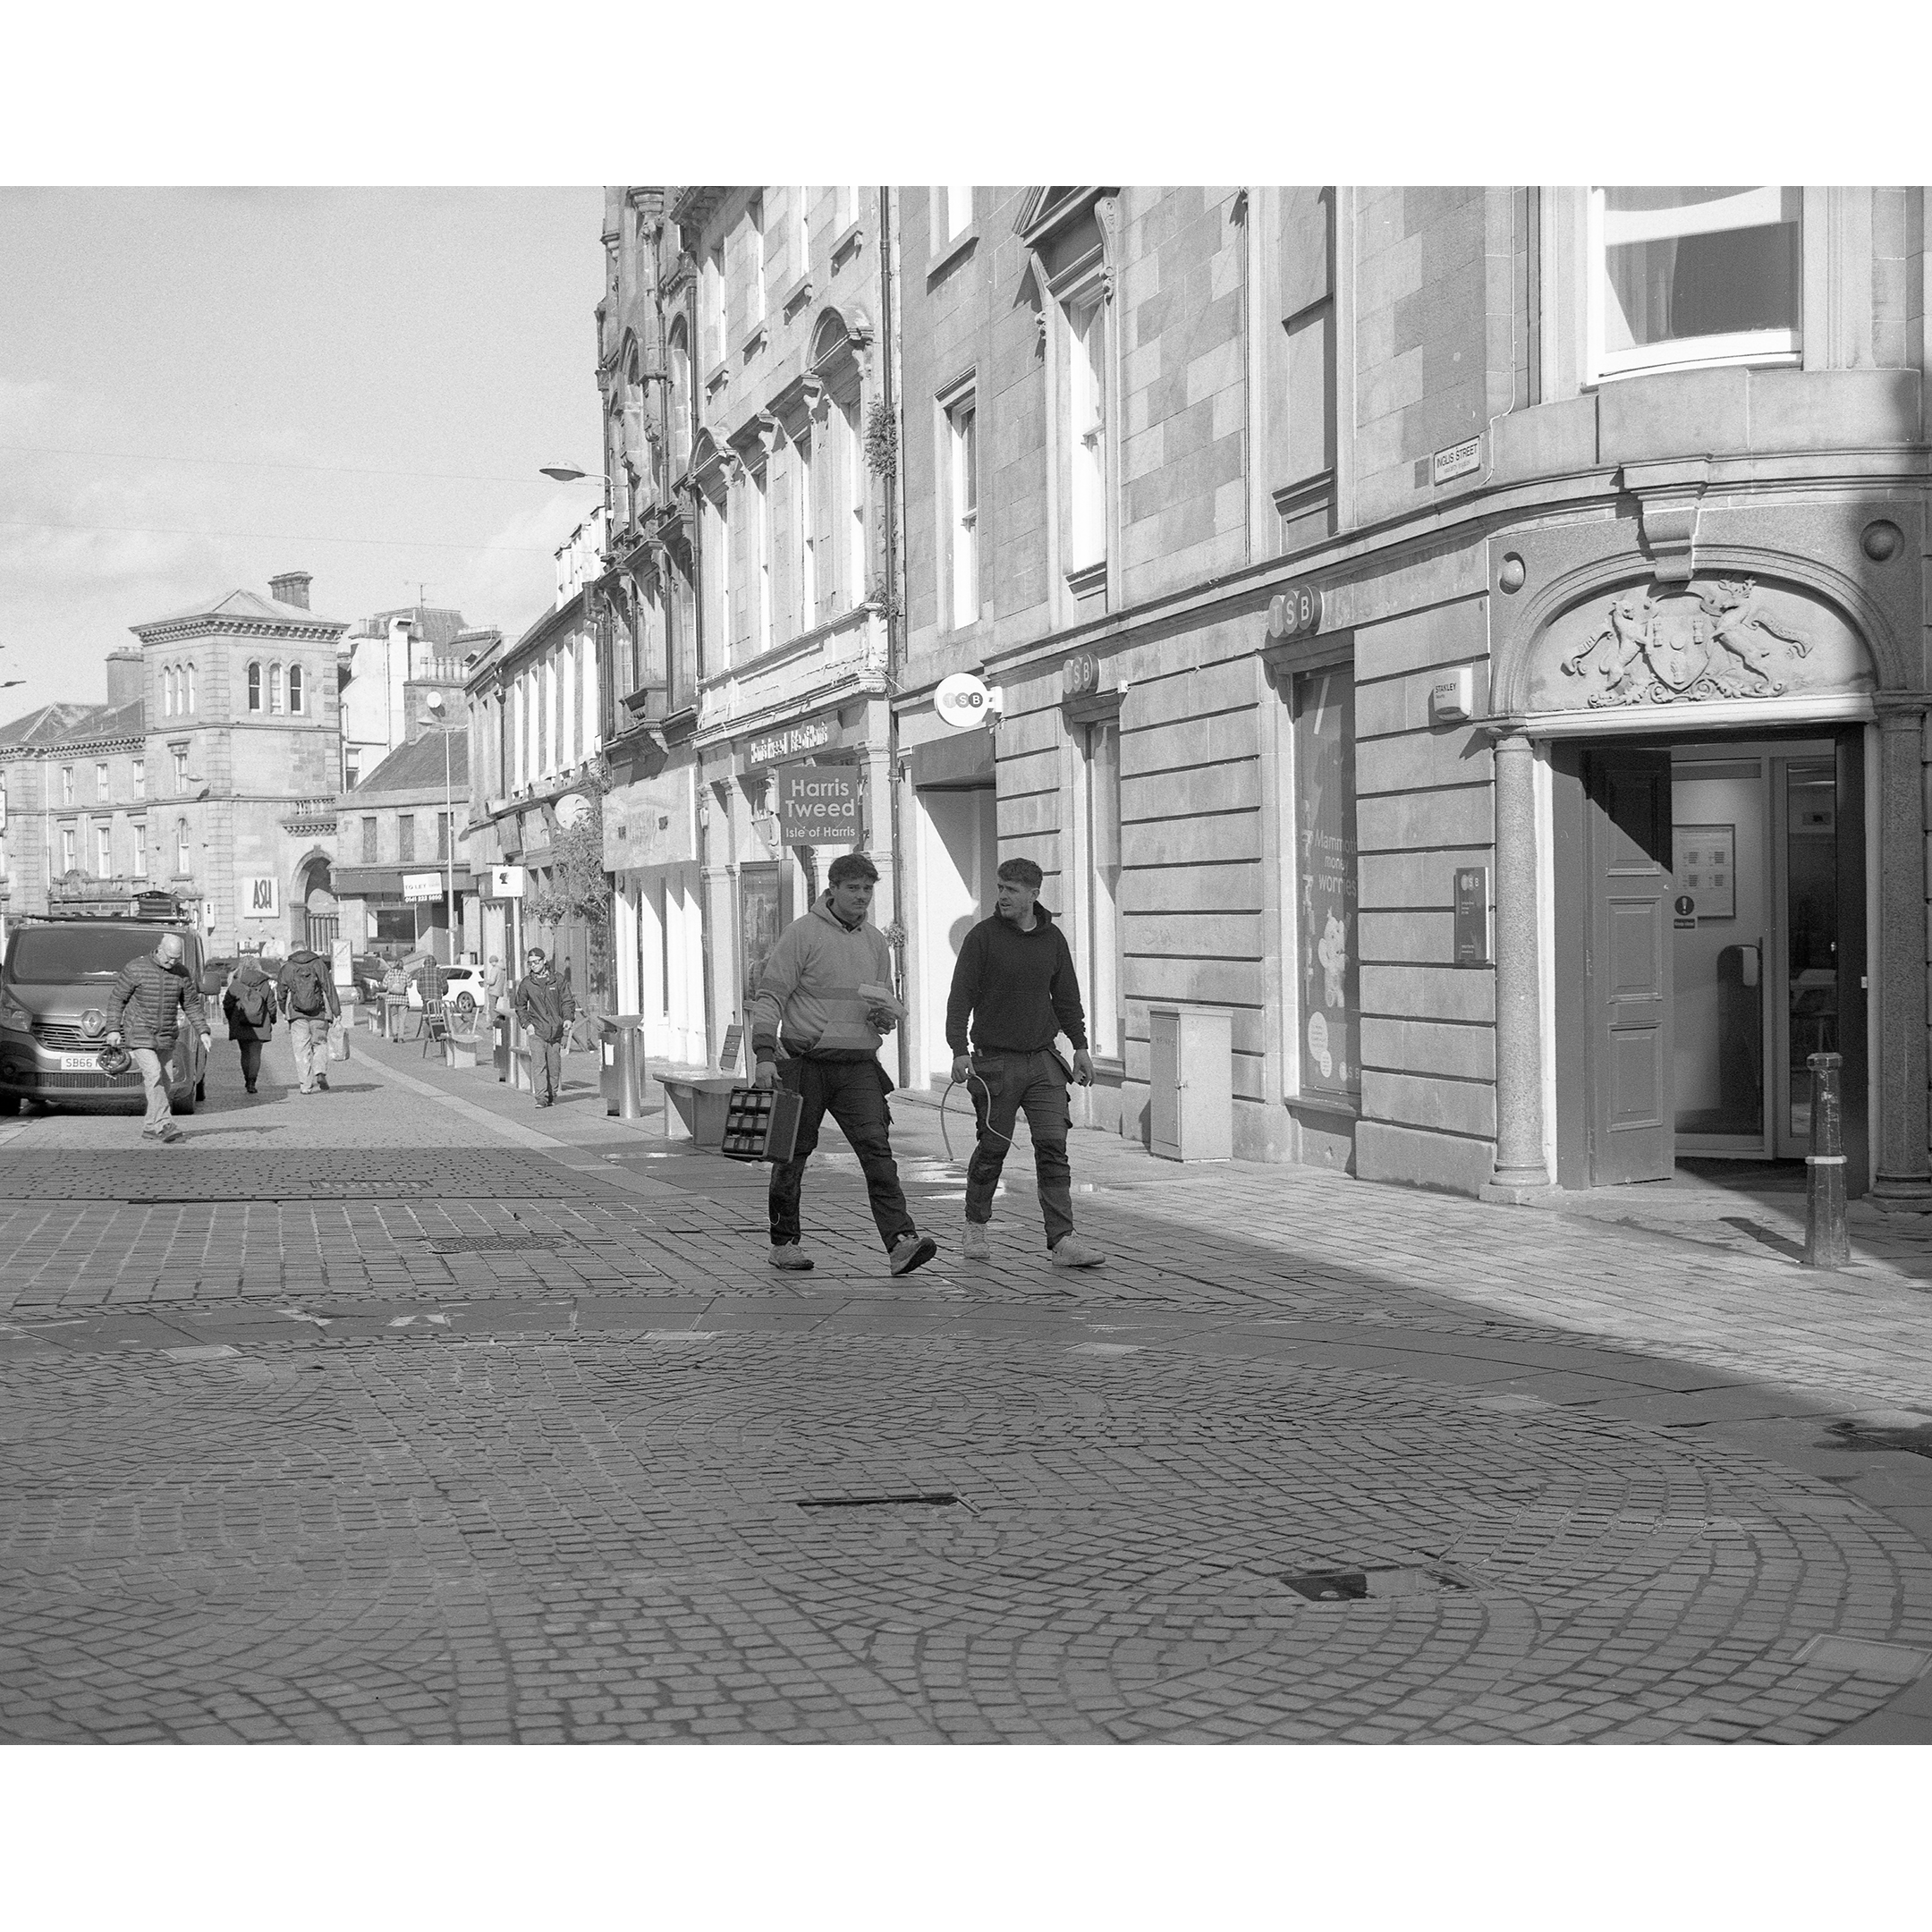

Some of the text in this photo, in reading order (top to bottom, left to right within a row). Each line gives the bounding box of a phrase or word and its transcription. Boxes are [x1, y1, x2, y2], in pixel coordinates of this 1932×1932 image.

[1455, 443, 1478, 462] STREET
[1271, 592, 1311, 631] TSB
[1064, 659, 1090, 686] TSB
[945, 694, 981, 706] TSB
[791, 778, 849, 797] Harris
[785, 799, 855, 818] Tweed
[786, 826, 855, 838] Isle of Harris
[1315, 829, 1357, 854] Mammoth
[1325, 856, 1349, 877] money
[1318, 874, 1357, 897] worries
[65, 1058, 93, 1068] SB66
